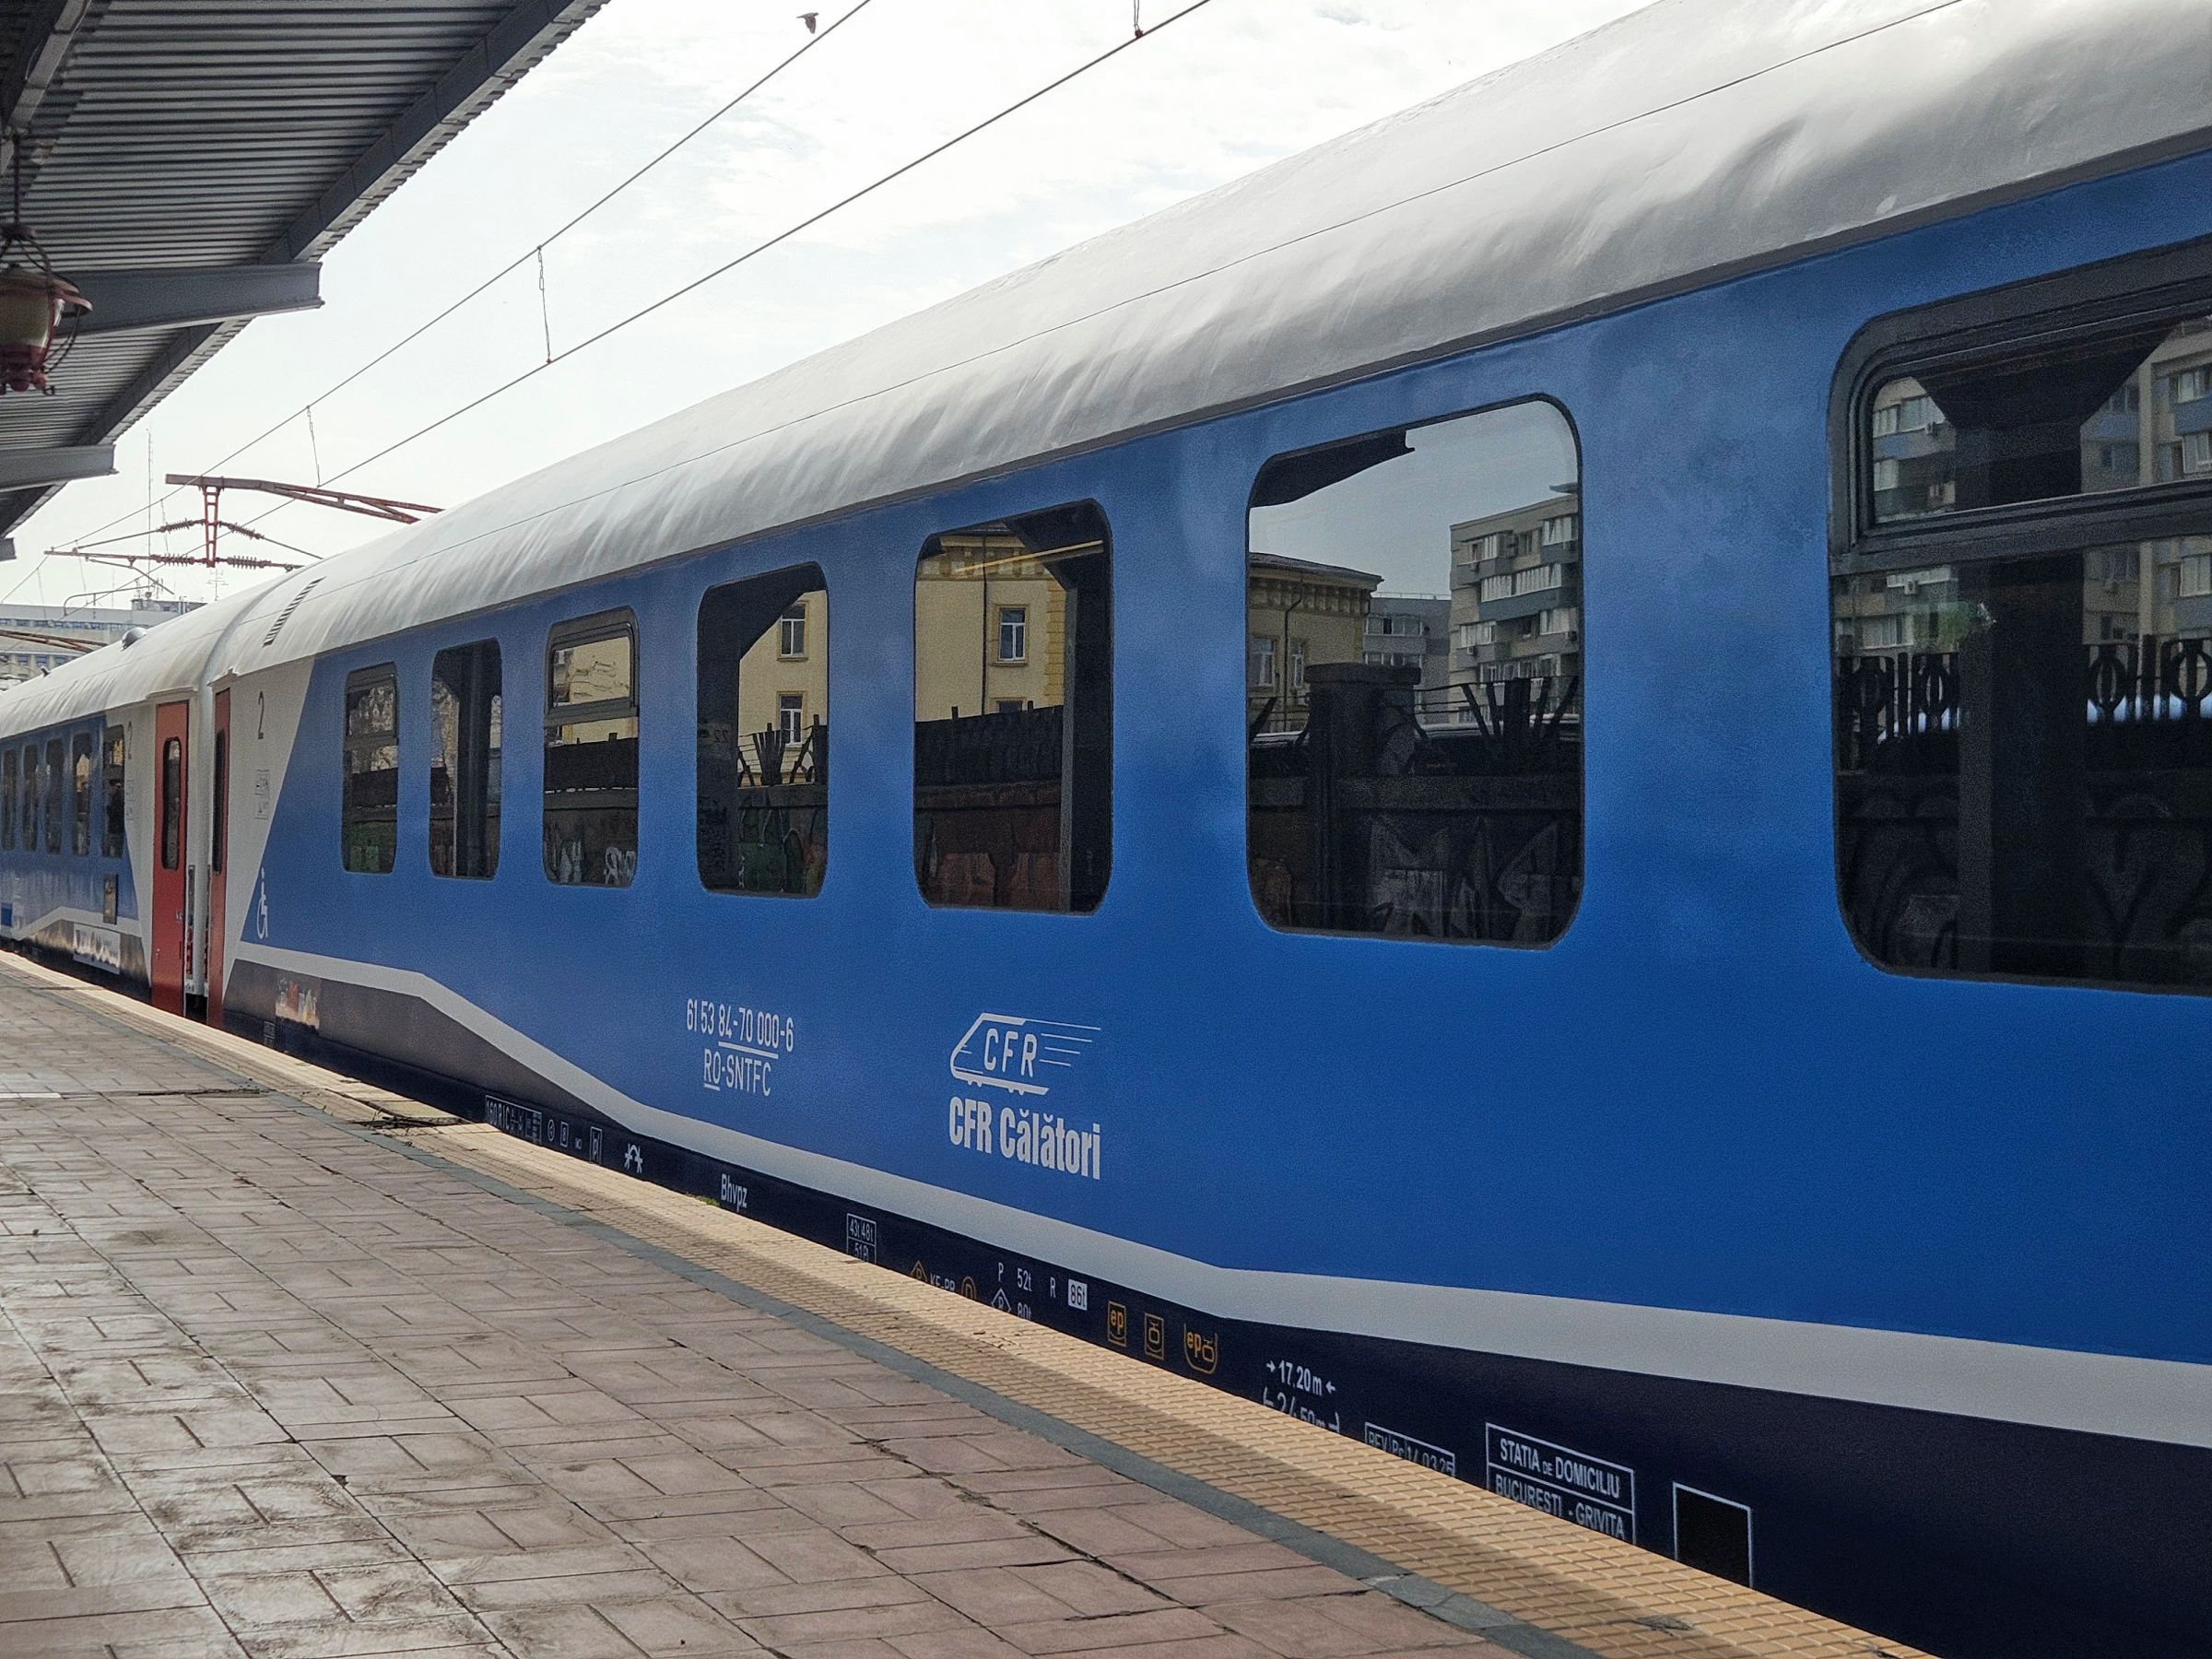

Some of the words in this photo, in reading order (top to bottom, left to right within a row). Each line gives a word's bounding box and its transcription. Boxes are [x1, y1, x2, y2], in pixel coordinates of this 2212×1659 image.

[257, 690, 265, 740] 2
[687, 998, 698, 1032] 61
[700, 1000, 715, 1035] 53
[718, 1003, 754, 1042] 84-70
[757, 1011, 794, 1053] 000-6
[703, 1048, 771, 1097] RO-SNTFC
[983, 1028, 1038, 1078] CFR
[948, 1096, 993, 1154] CFR
[999, 1107, 1100, 1181] Călători
[721, 1172, 747, 1213] Bhvpz
[998, 1262, 1005, 1282] P
[1018, 1267, 1032, 1292] 52t
[1051, 1277, 1056, 1299] R
[1111, 1310, 1124, 1335] ep
[1500, 1438, 1541, 1472] STATIA
[1542, 1461, 1554, 1477] DE
[1555, 1456, 1620, 1499] DOMICILIU
